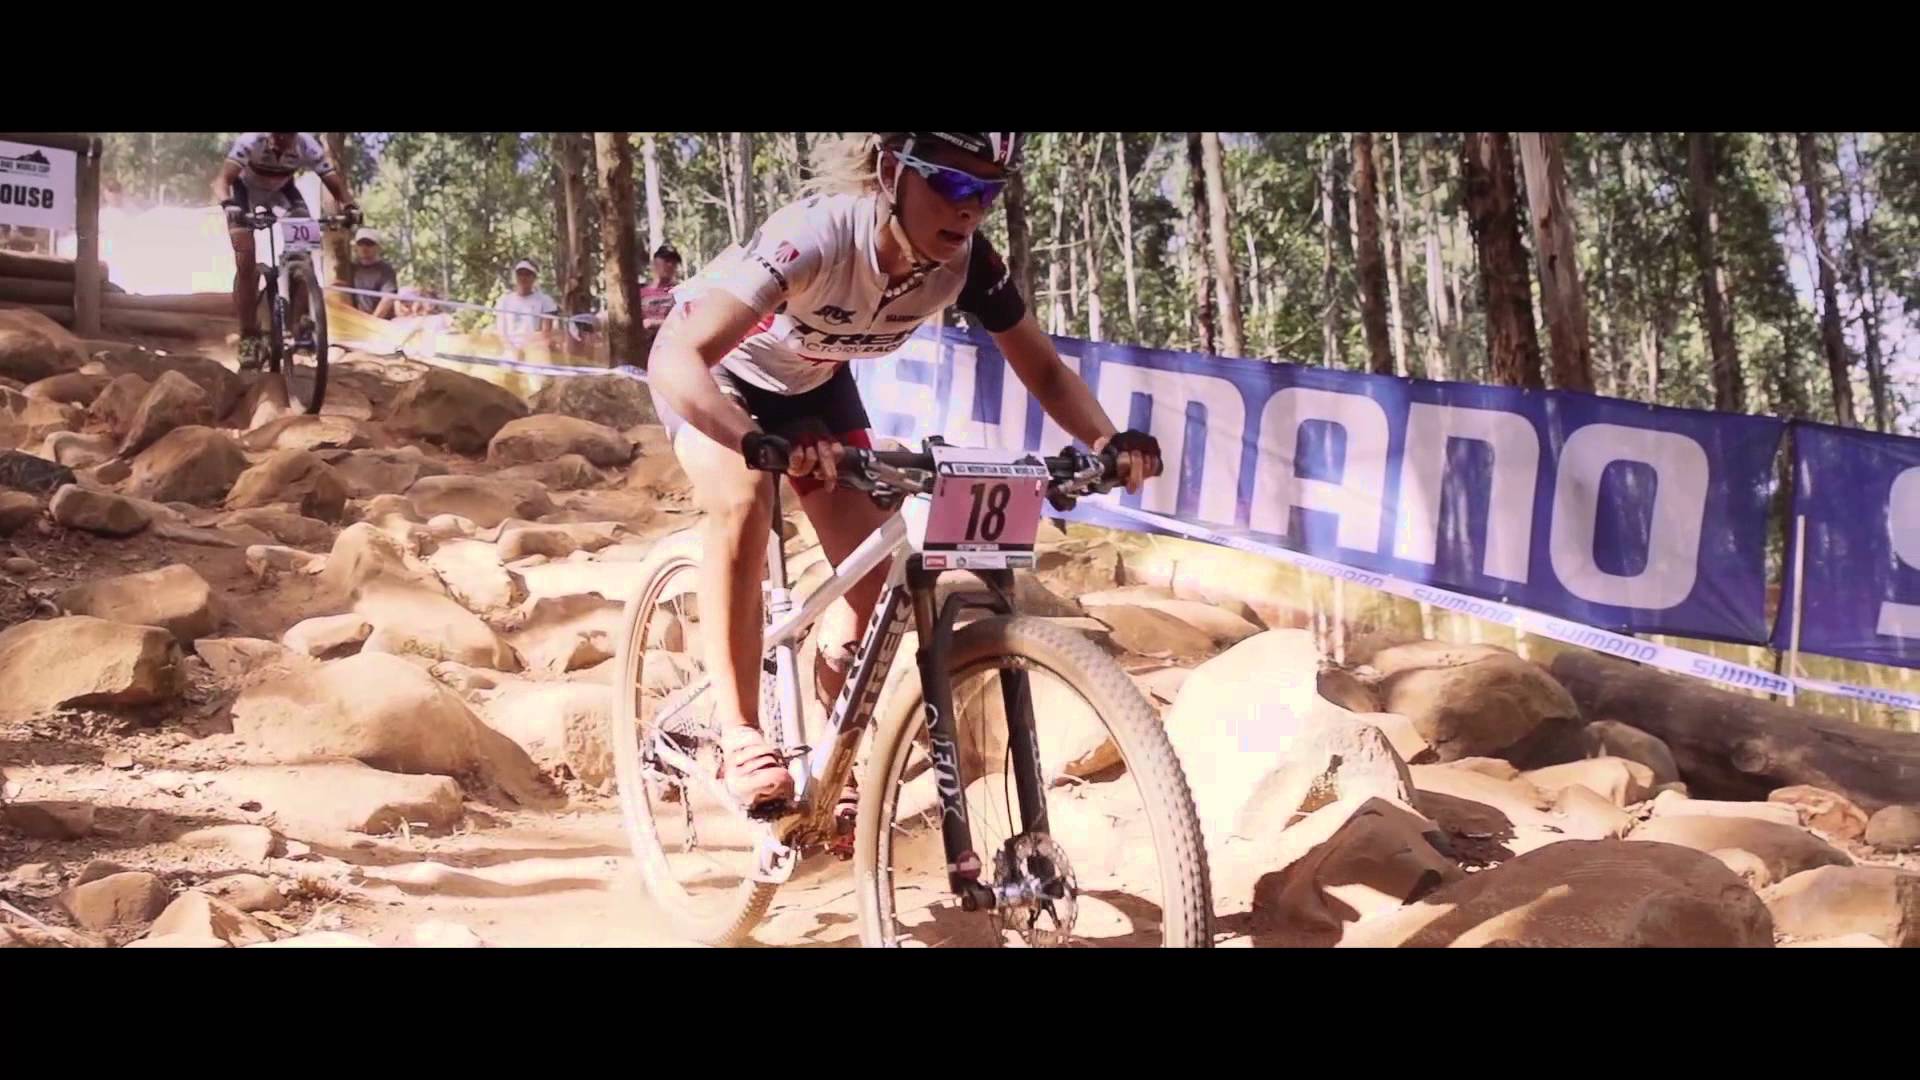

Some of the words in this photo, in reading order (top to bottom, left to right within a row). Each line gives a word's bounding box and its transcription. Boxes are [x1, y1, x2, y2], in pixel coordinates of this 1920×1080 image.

[0, 183, 54, 209] ouse
[291, 225, 310, 240] 20
[964, 483, 1011, 542] 18
[1544, 621, 1658, 662] SHIMANO
